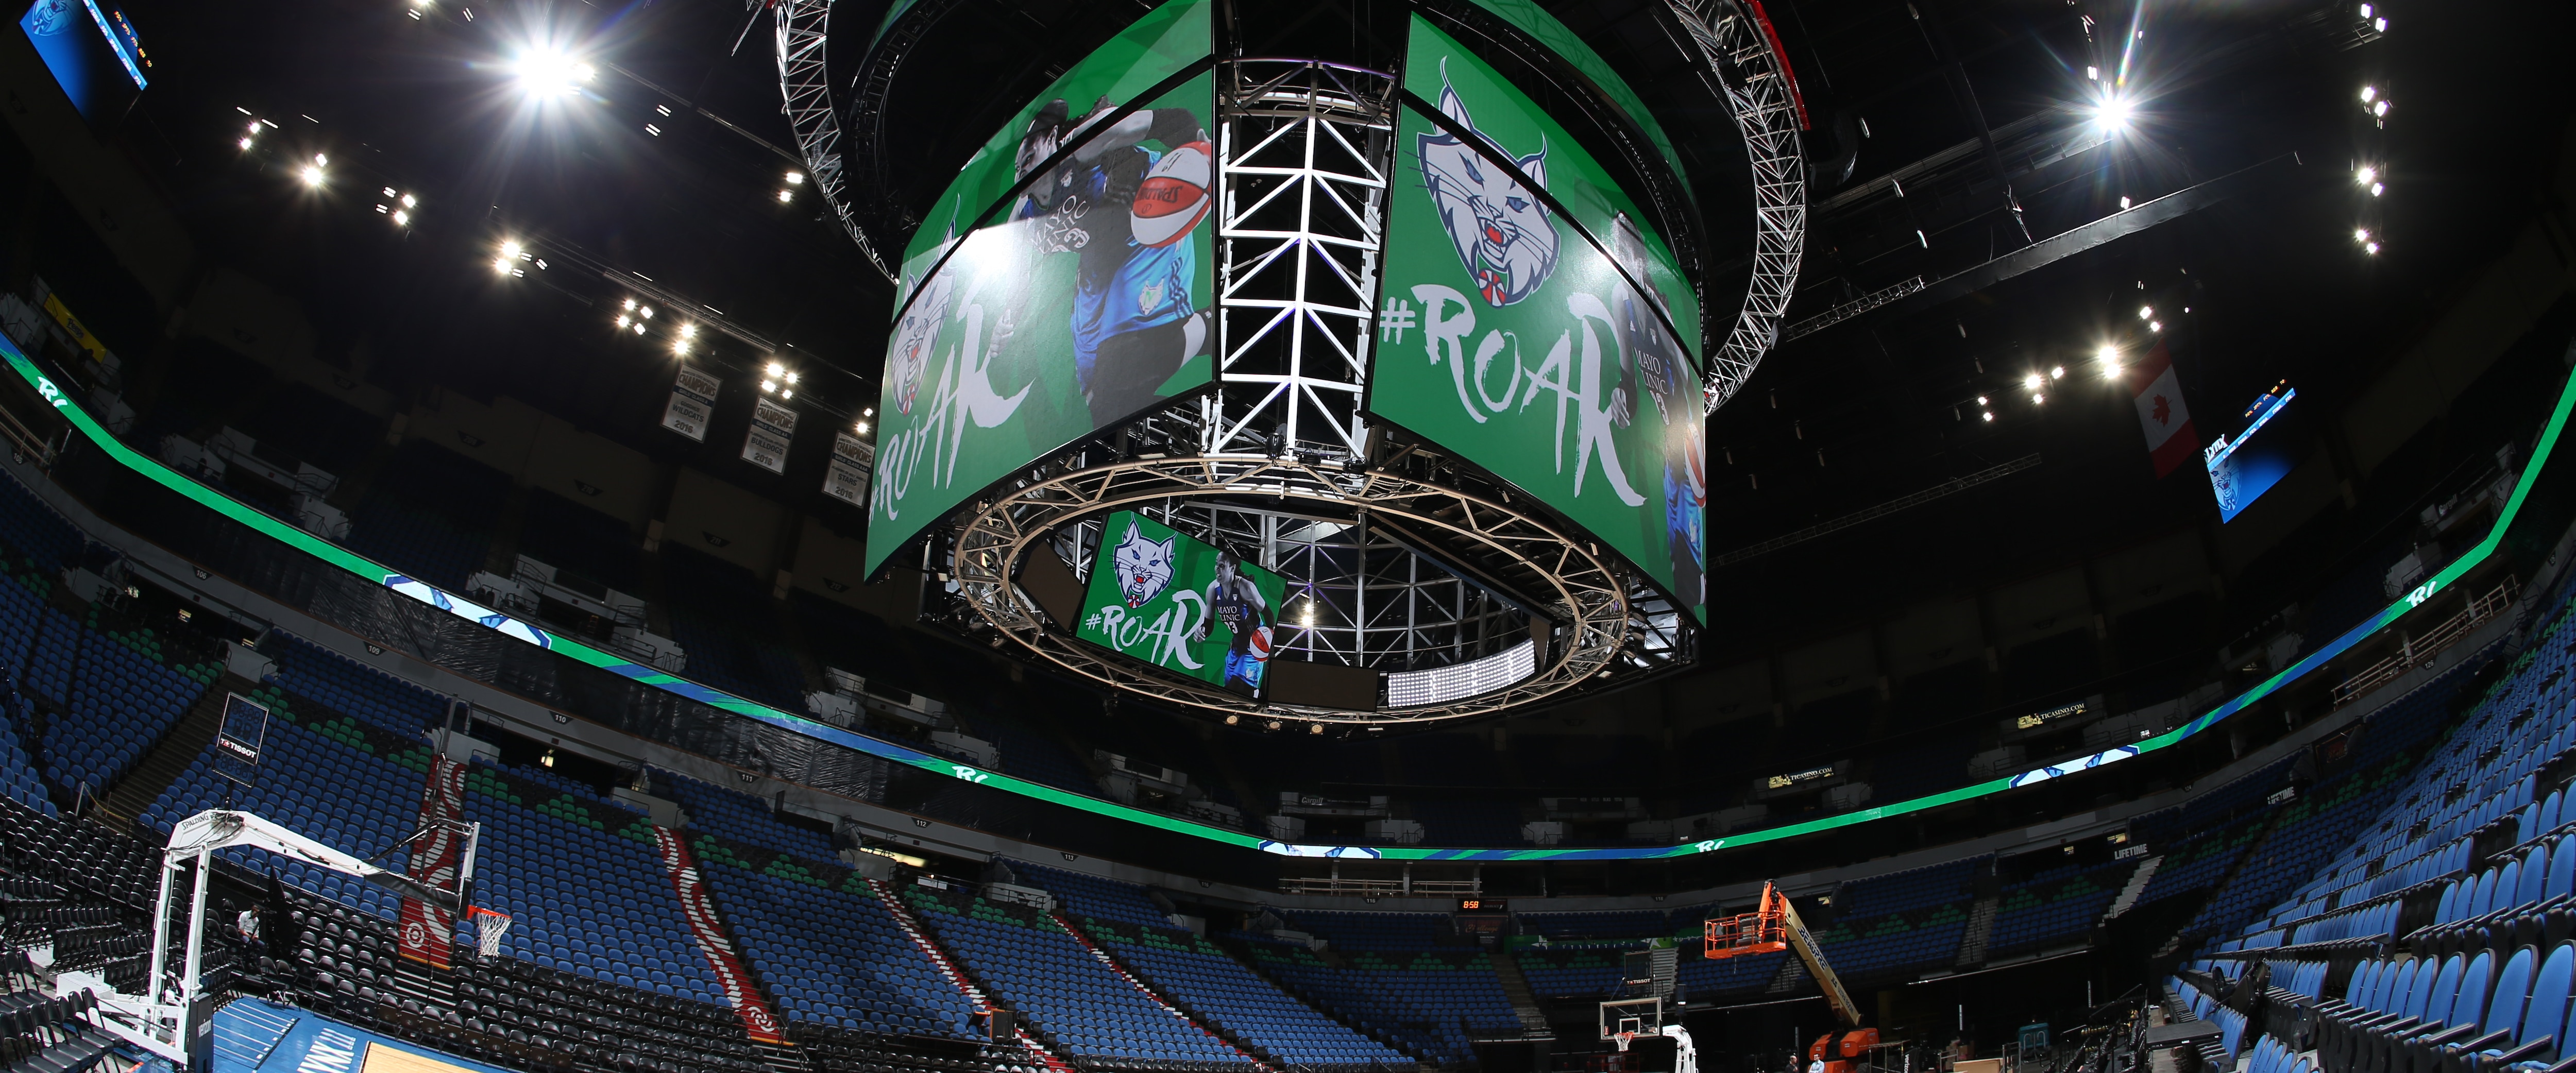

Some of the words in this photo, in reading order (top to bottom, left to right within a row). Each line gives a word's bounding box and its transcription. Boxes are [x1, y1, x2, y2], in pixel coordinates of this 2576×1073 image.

[1030, 195, 1077, 246] MAYO
[1039, 200, 1090, 254] LINIC
[678, 373, 716, 397] CHAMPIONS
[1379, 284, 1648, 507] #ROAR
[672, 404, 704, 422] WILDCATS
[757, 407, 793, 429] CHAMPIONS
[673, 419, 694, 433] 2016
[751, 436, 784, 455] BULLDOGS
[836, 441, 872, 463] CHAMPIONS
[754, 452, 773, 466] 2016
[837, 473, 857, 486] STARS
[835, 486, 854, 499] 2016
[197, 570, 207, 580] 106
[1086, 589, 1206, 670] #ROAR
[368, 645, 380, 655] 109
[2425, 659, 2434, 669] 126
[555, 714, 567, 723] 110
[2041, 703, 2085, 719] TICASINO.COM
[230, 742, 257, 758] TISSOT
[742, 774, 753, 782] 111
[1790, 767, 1833, 780] TICASINO.COM
[1301, 797, 1323, 805] Cargill
[182, 813, 209, 831] SPALDING
[917, 819, 927, 828] 112
[2114, 843, 2147, 860] LIFETIME
[1797, 926, 1827, 971] BEAUPRE
[198, 1018, 211, 1038] verizon
